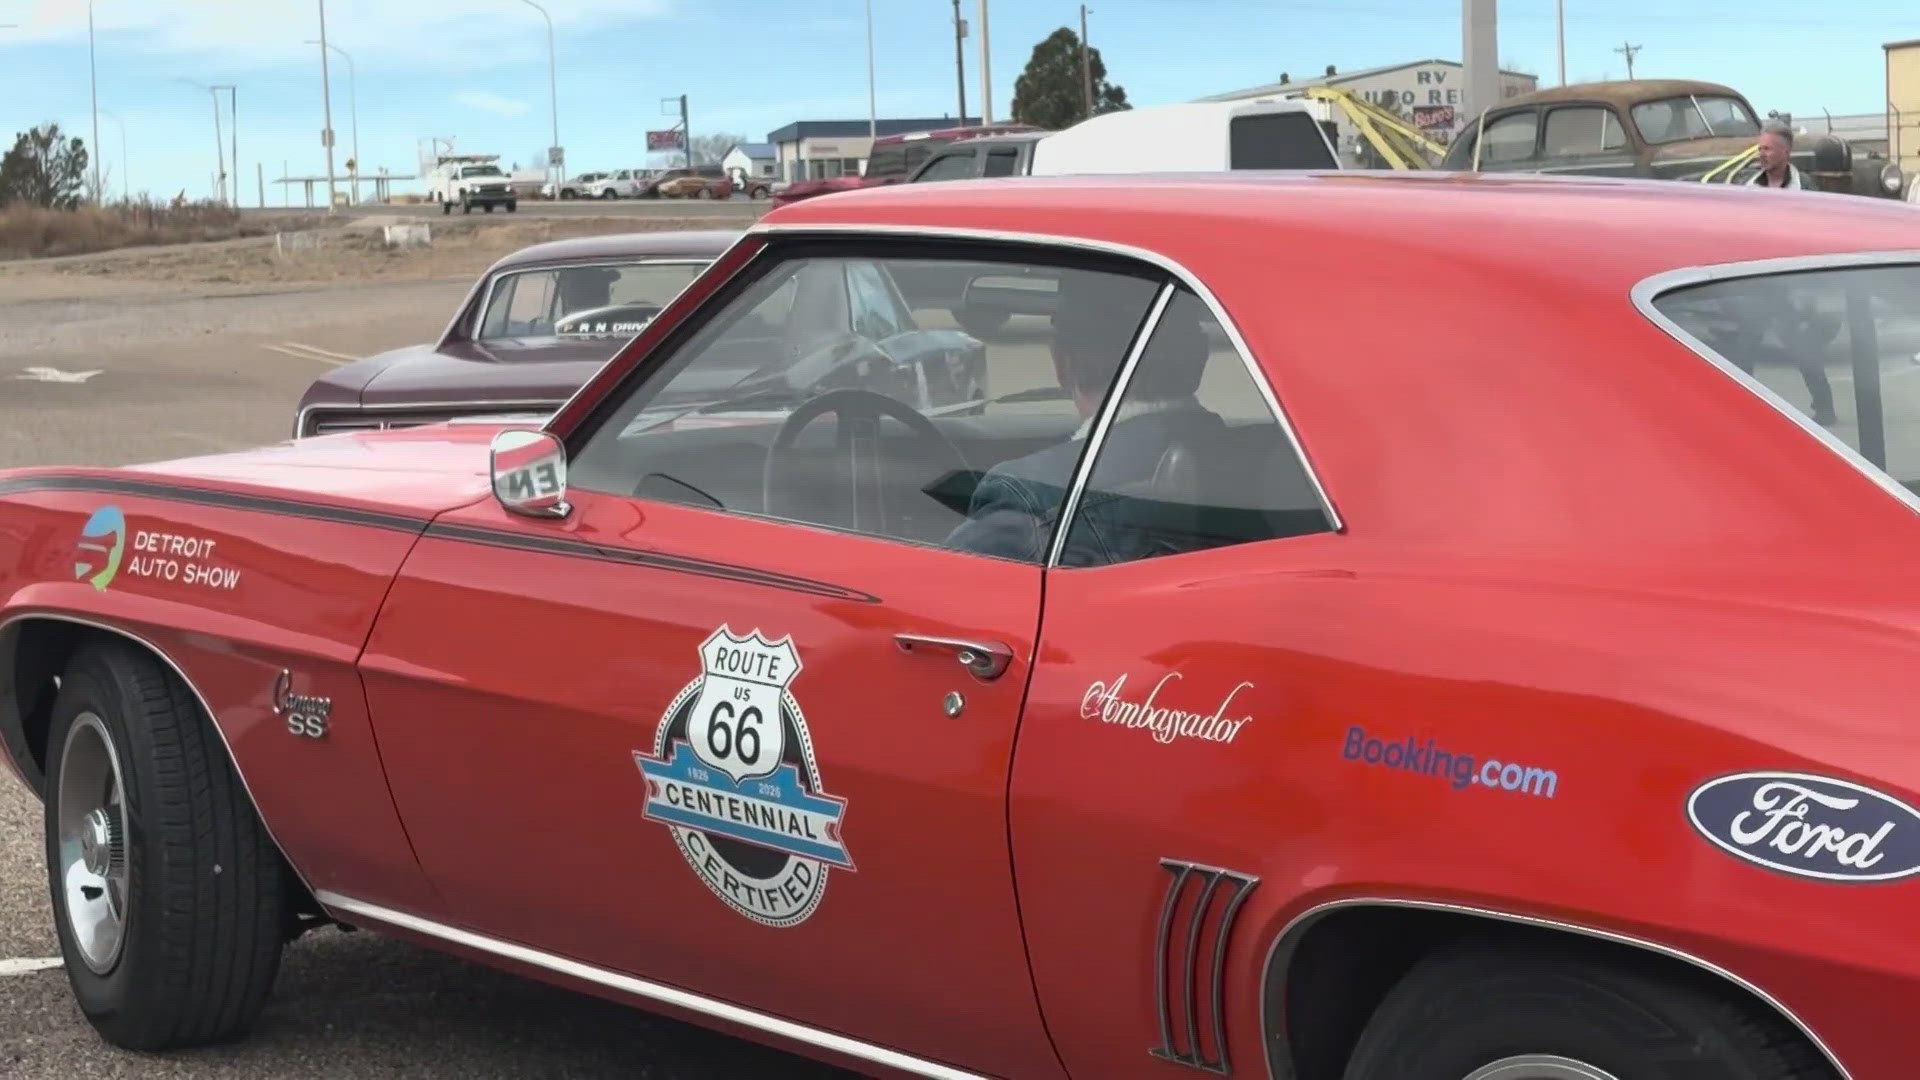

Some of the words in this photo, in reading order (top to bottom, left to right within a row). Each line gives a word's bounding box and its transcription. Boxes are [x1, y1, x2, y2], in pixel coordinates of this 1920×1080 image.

[1417, 71, 1447, 84] RV
[1428, 89, 1464, 104] RE
[595, 322, 607, 333] N
[133, 530, 217, 558] DETROIT
[127, 555, 179, 581] AUTO
[183, 562, 241, 590] SHOW
[714, 646, 781, 681] ROUTE
[734, 686, 752, 702] US
[1080, 672, 1254, 744] Ambassador
[287, 713, 323, 738] SS
[707, 701, 763, 766] 66
[1342, 725, 1559, 799] Booking.com
[665, 782, 818, 840] CENTENNIAL
[1730, 781, 1896, 869] Ford
[686, 832, 813, 913] CERTIFIED
